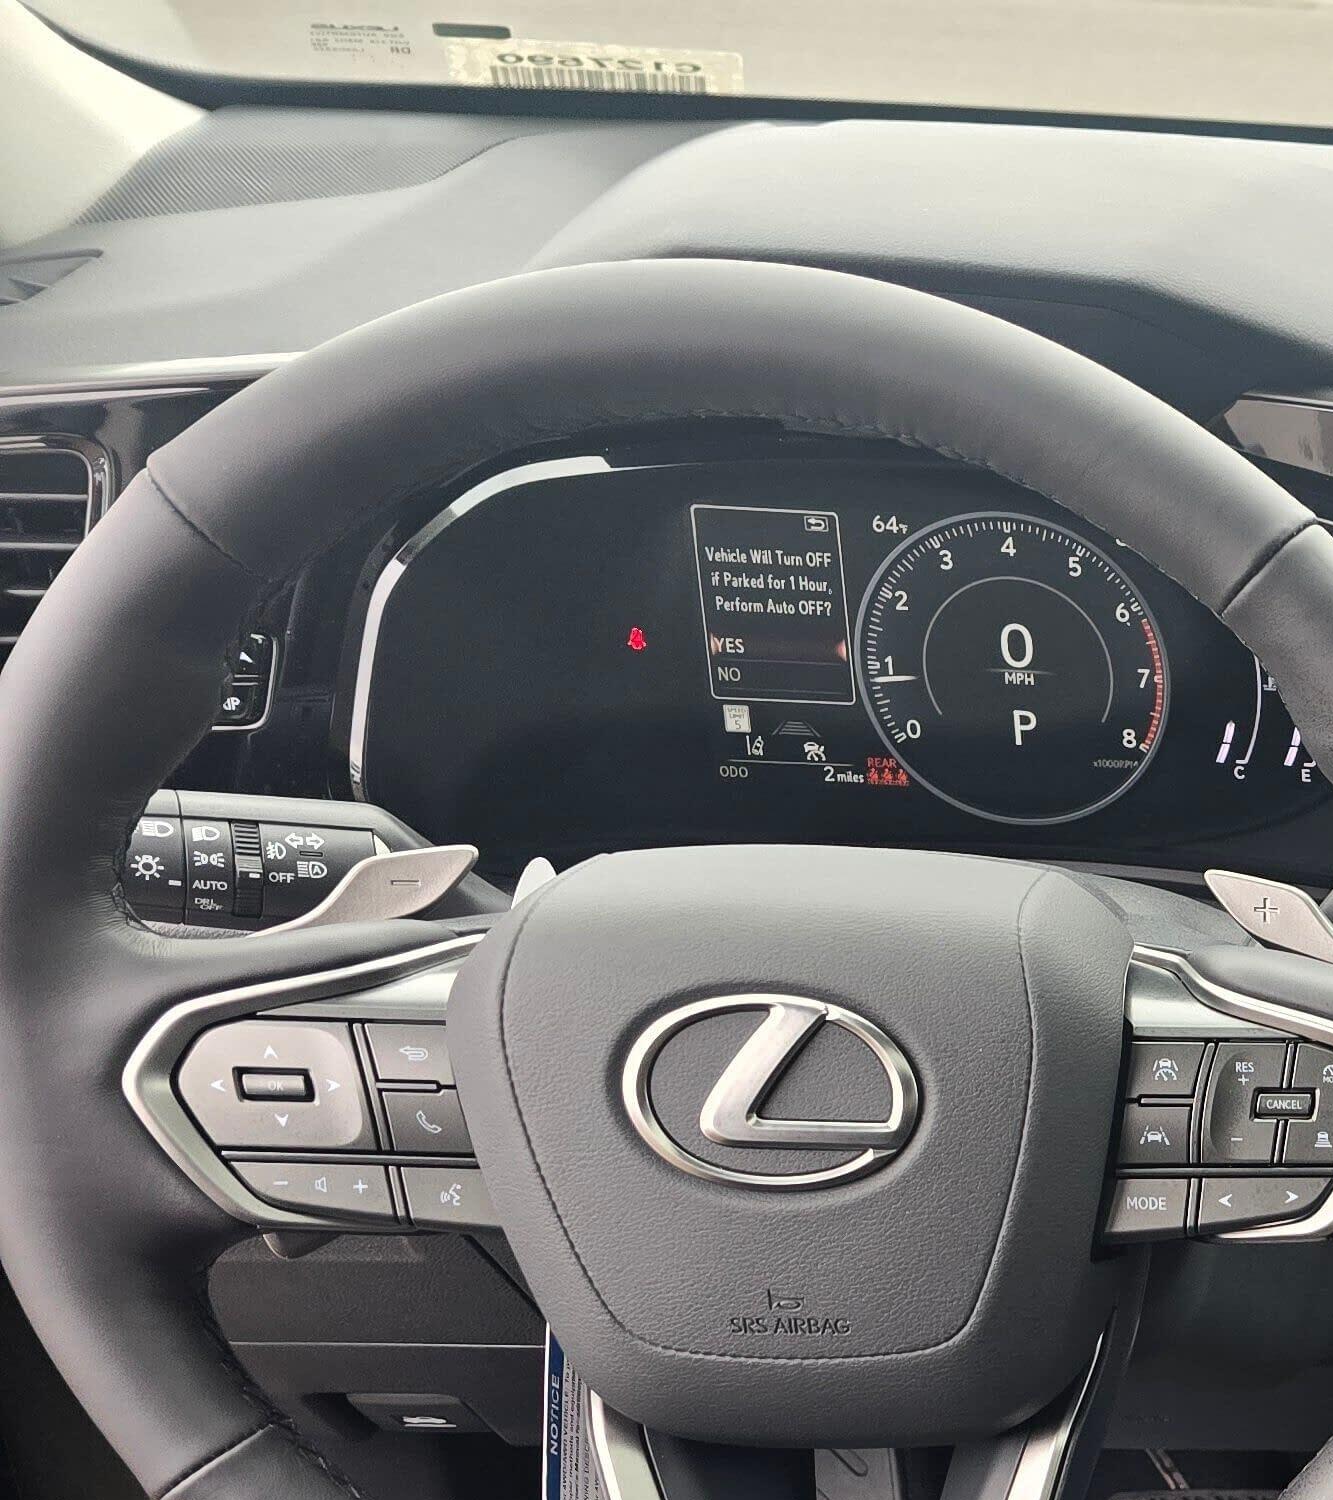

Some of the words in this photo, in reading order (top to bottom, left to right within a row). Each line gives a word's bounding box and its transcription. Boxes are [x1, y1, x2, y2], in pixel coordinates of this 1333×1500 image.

[1000, 537, 1017, 557] 4
[705, 547, 747, 564] Vehicle
[750, 549, 772, 565] Will
[775, 550, 803, 566] Turn
[806, 552, 832, 567] OFF
[939, 550, 954, 570] 3
[1068, 557, 1082, 577] 5
[711, 572, 720, 587] if
[724, 572, 764, 589] Parked
[768, 575, 785, 590] for
[790, 576, 796, 590] 1
[715, 596, 764, 613] Perform
[767, 599, 795, 615] Auto
[799, 600, 832, 616] OFF?
[894, 591, 909, 611] 2
[1115, 602, 1130, 623] 6
[715, 637, 745, 653] YES
[1001, 623, 1034, 668] 0
[717, 666, 741, 682] NO
[884, 655, 894, 675] 1
[1004, 672, 1035, 686] MPH
[1137, 669, 1150, 688] 7
[906, 719, 921, 739] 0
[1012, 710, 1037, 745] P
[1122, 729, 1136, 748] 8
[719, 765, 748, 778] ODO
[867, 757, 897, 769] REAR
[824, 765, 835, 782] 2
[837, 772, 864, 784] miles
[1233, 766, 1245, 779] C
[1301, 769, 1311, 782] E
[192, 879, 228, 891] AUTO
[268, 872, 295, 884] OFF
[1235, 1061, 1255, 1074] RES
[267, 1080, 284, 1092] OK
[1266, 1099, 1302, 1111] CANCEL
[1126, 1196, 1168, 1211] MODE
[730, 1317, 768, 1334] SRS
[773, 1317, 852, 1335] AIRBAG
[550, 1374, 560, 1456] NOTICE
